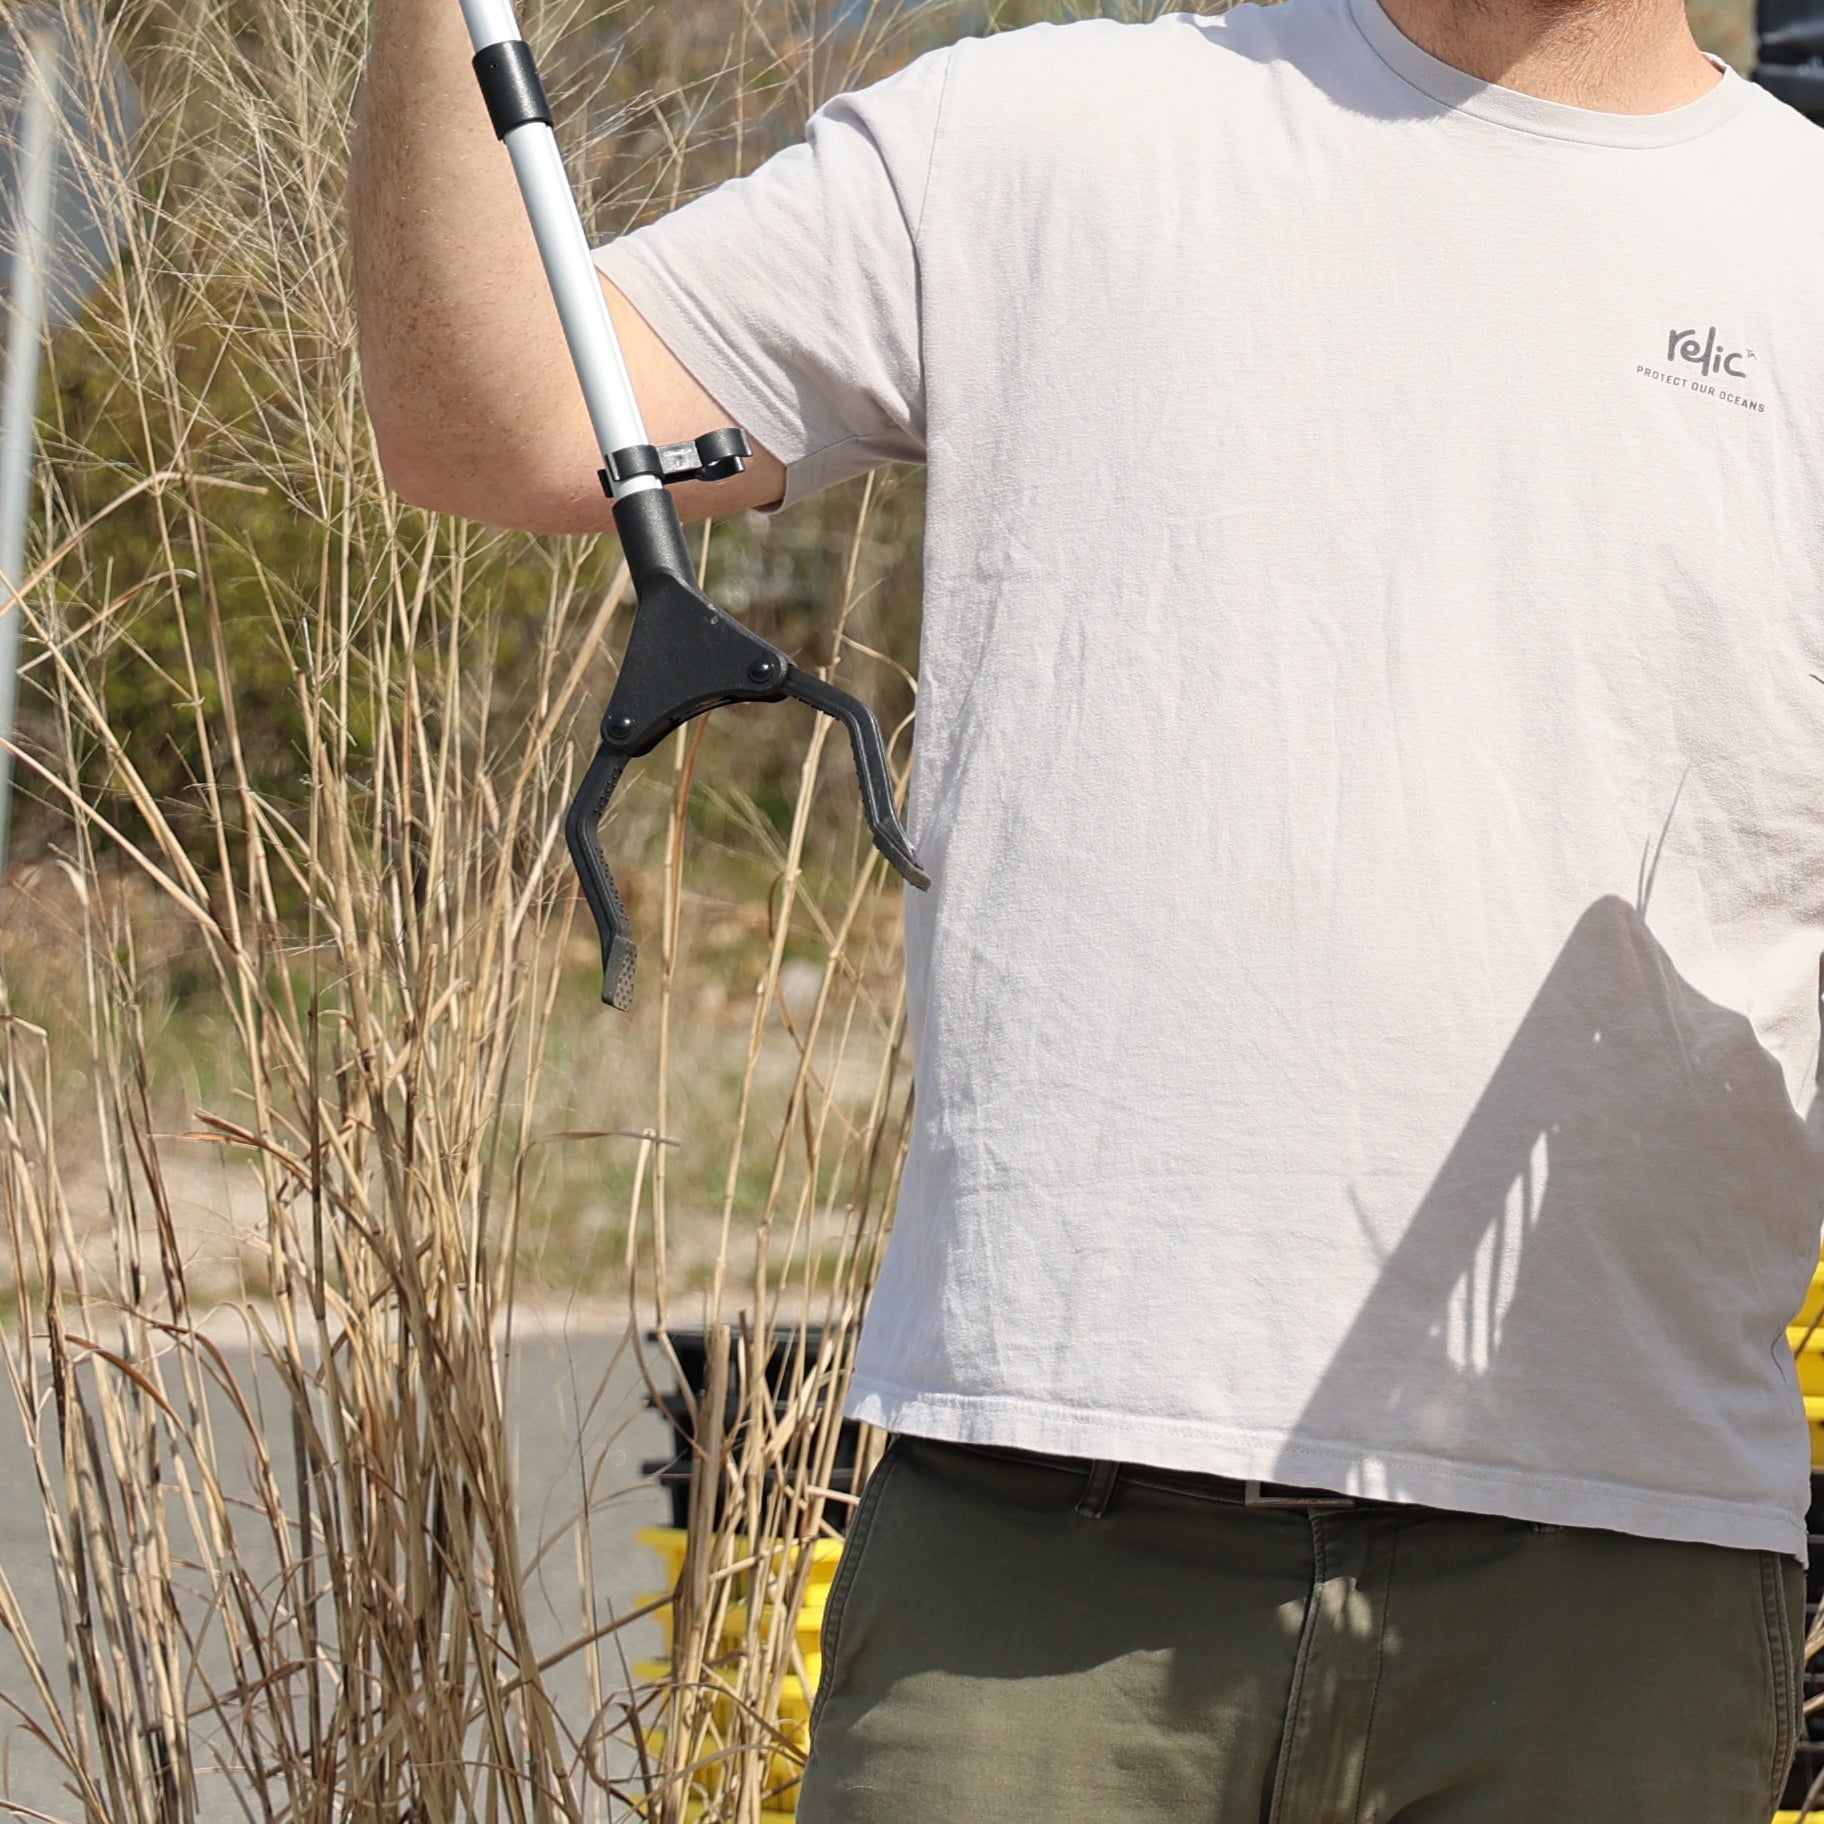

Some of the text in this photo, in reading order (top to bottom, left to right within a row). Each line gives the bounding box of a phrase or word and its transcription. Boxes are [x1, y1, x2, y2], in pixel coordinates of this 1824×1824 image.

[1667, 326, 1747, 379] relic
[1636, 365, 1766, 414] PROTECT OUR OCEANS
